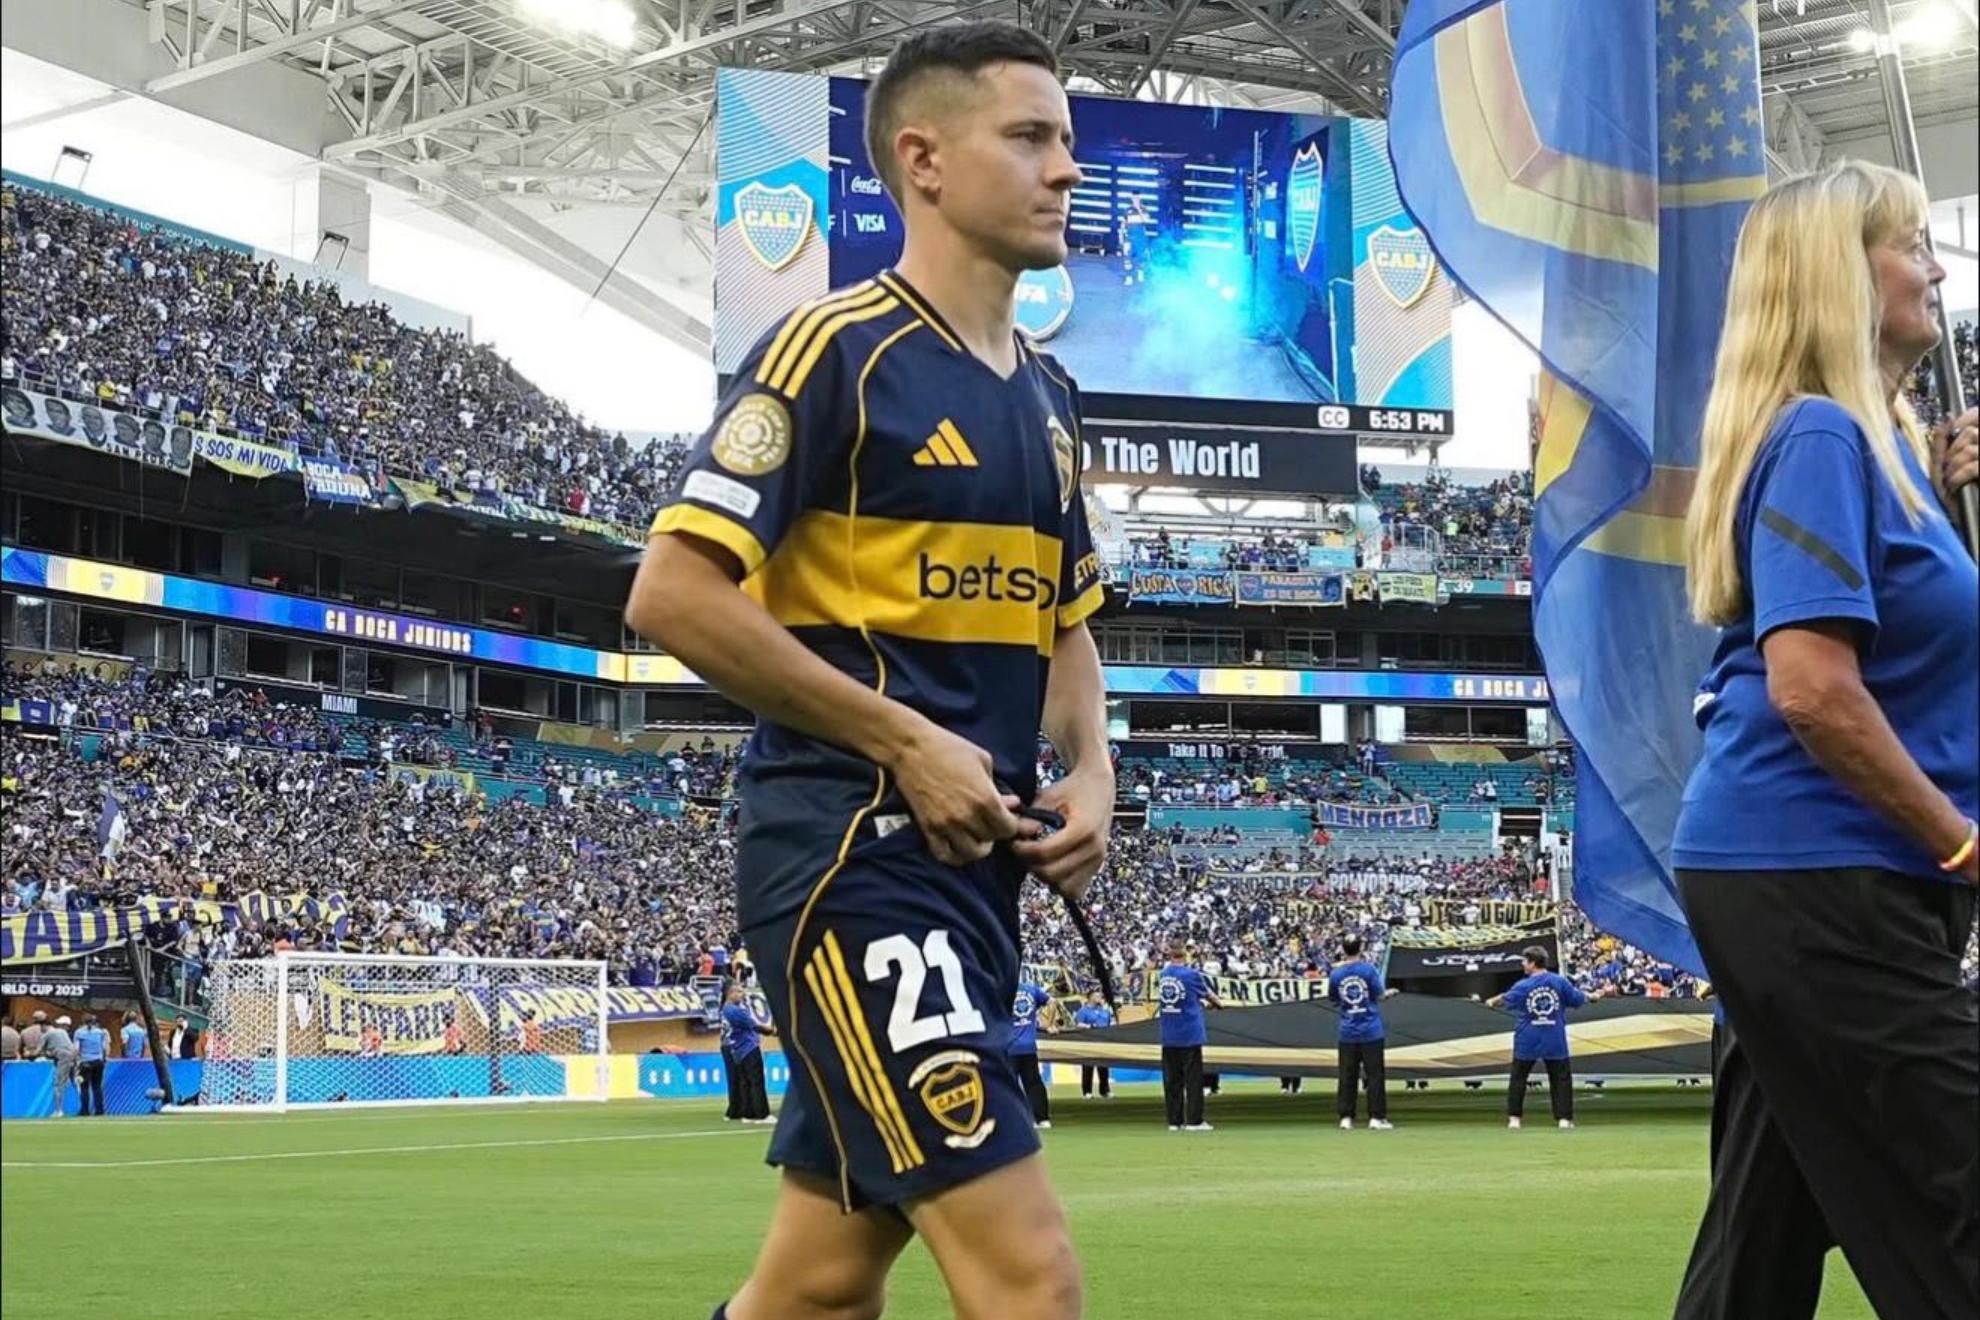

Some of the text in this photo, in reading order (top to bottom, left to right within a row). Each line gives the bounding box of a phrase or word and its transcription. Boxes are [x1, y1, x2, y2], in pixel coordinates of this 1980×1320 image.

[743, 210, 804, 229] CABJ
[853, 213, 886, 232] VISA
[1376, 252, 1428, 269] CABJ
[1417, 411, 1445, 433] PM
[206, 440, 234, 462] SOS
[238, 447, 256, 465] MI
[1101, 437, 1159, 474] The
[1167, 439, 1260, 478] World
[325, 609, 472, 654] CA BOCA JUNIORS
[1454, 679, 1475, 697] CA
[1483, 679, 1526, 698] BOCA
[321, 693, 358, 715] MIAMI
[1168, 742, 1197, 758] Take
[1211, 743, 1224, 759] To
[1319, 801, 1431, 828] MENDOZA
[29, 983, 54, 998] CUP
[863, 929, 987, 1053] 21
[935, 1083, 976, 1108] CABJ
